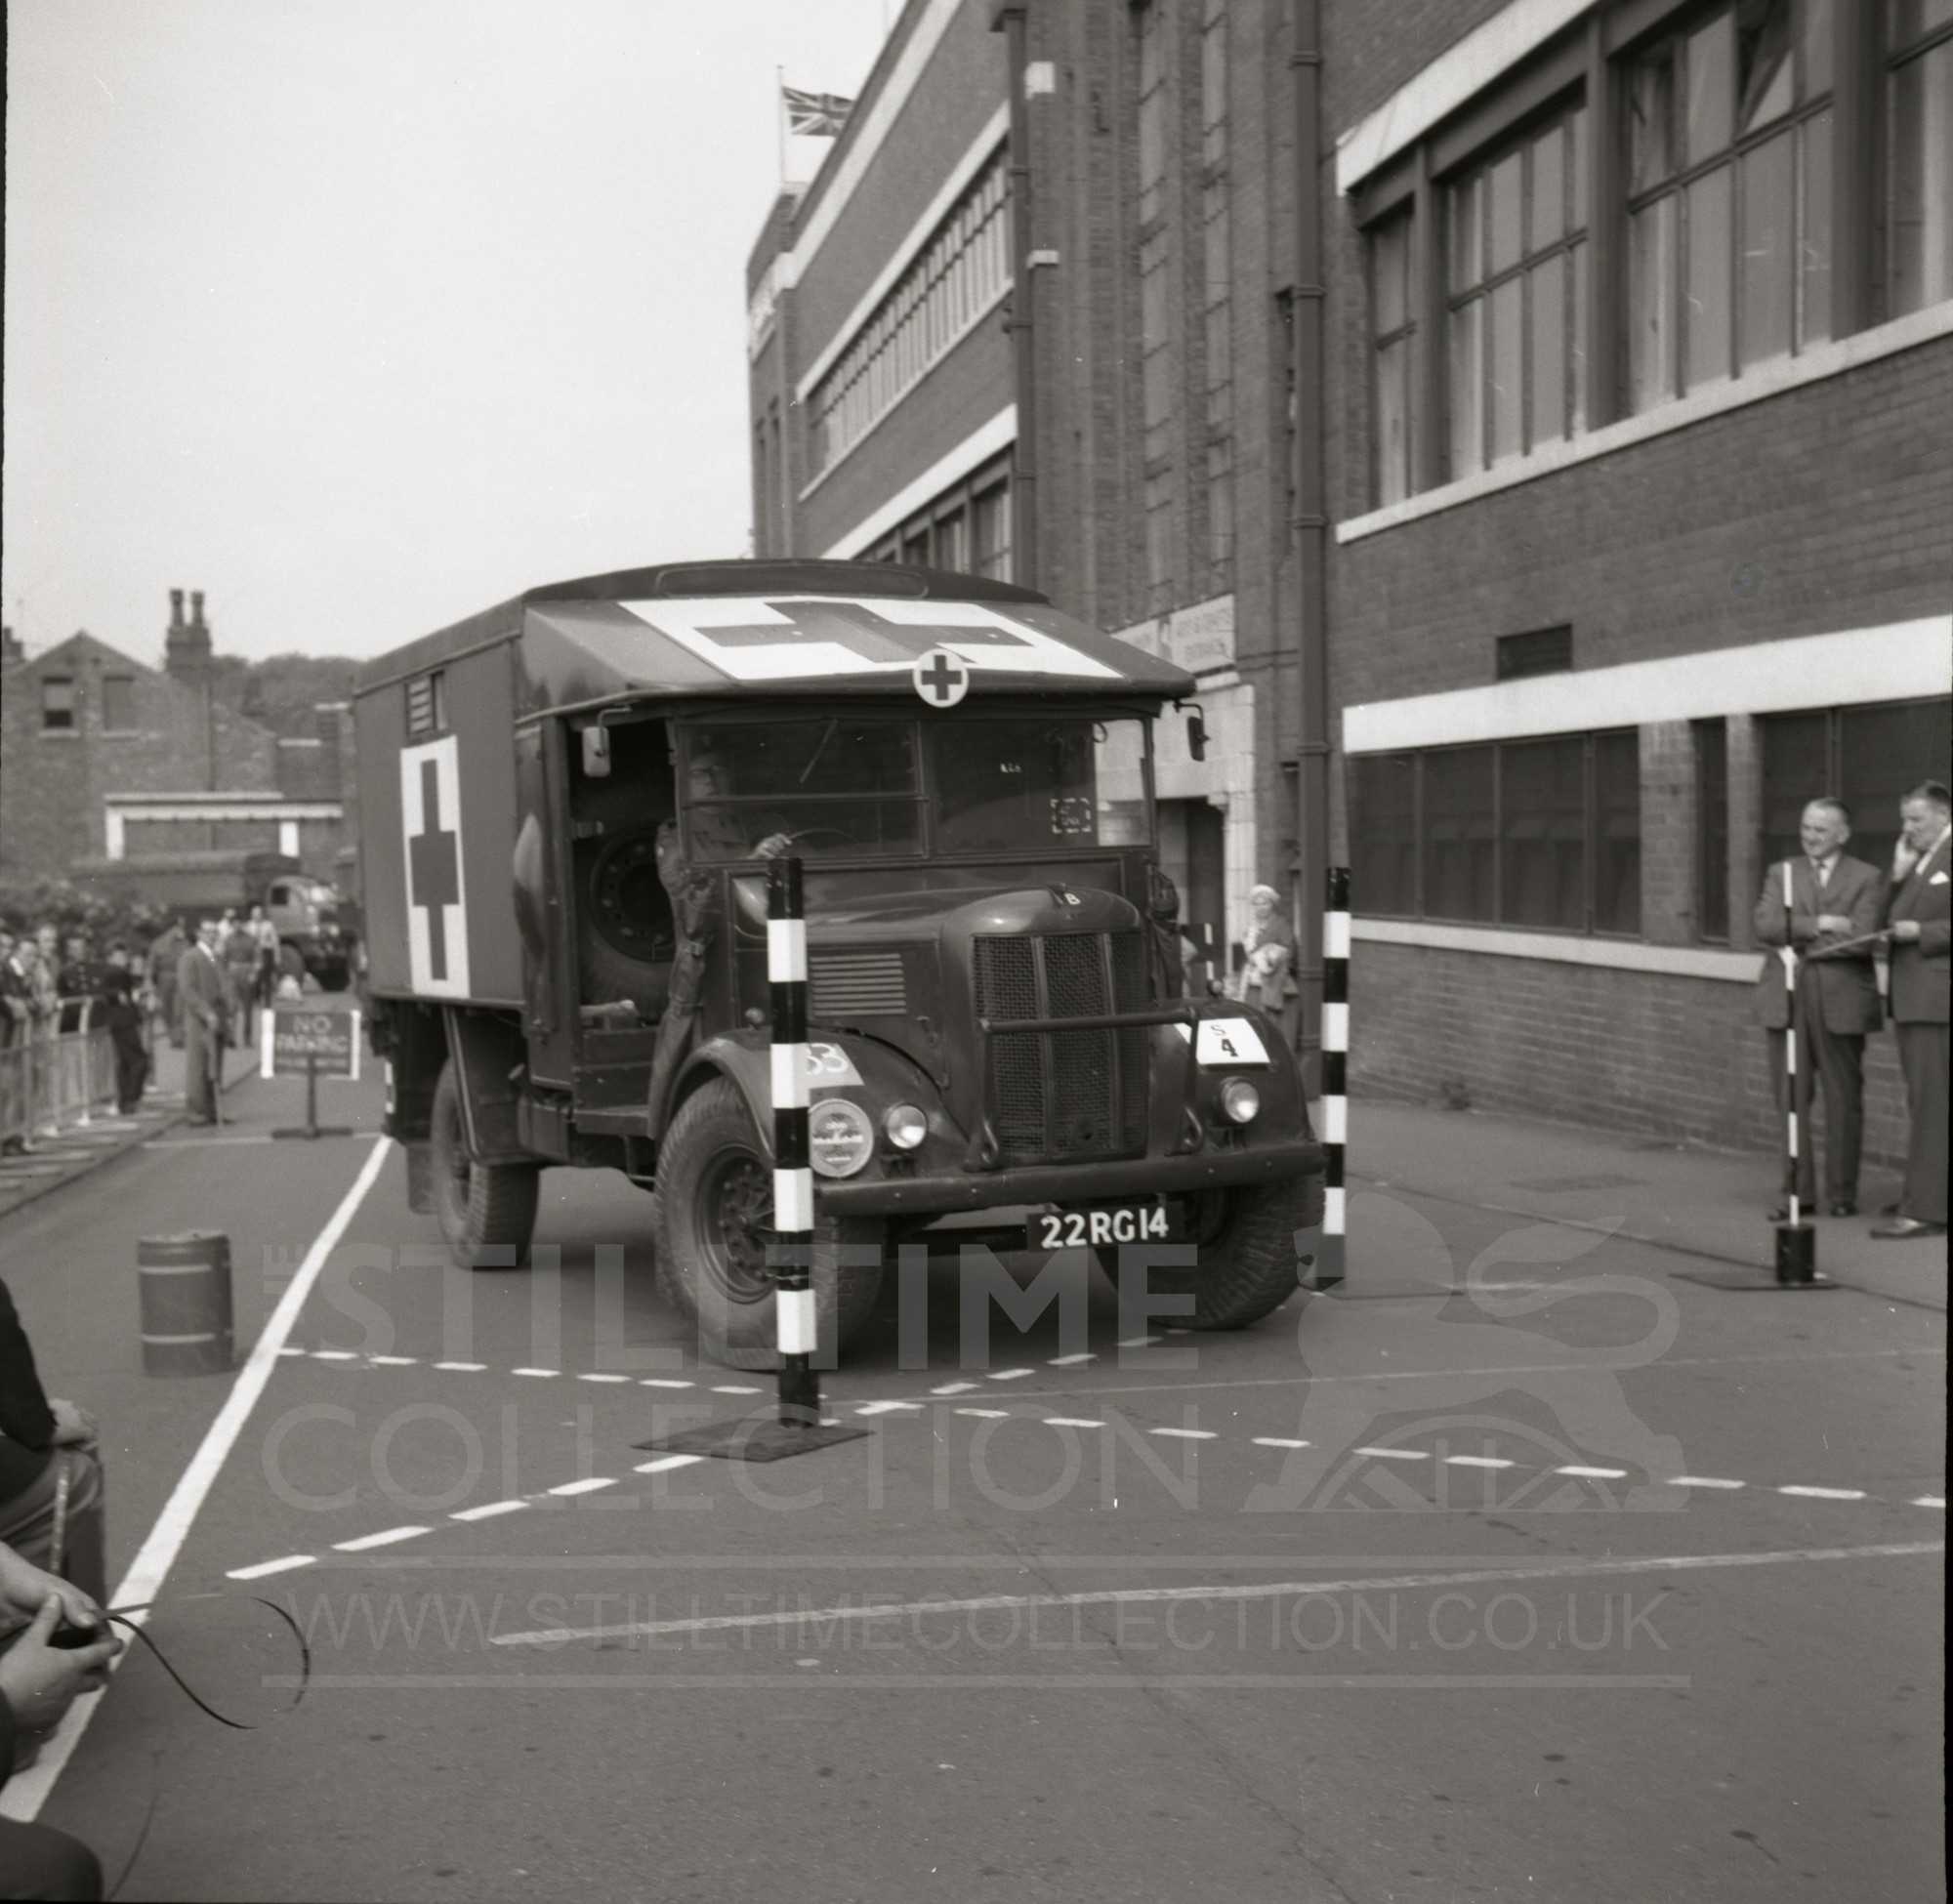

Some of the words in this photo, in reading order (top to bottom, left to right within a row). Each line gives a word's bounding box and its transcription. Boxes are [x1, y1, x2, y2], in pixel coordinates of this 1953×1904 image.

[293, 1014, 333, 1035] NO
[1221, 1038, 1239, 1057] 4
[1040, 1207, 1170, 1249] 22RG14
